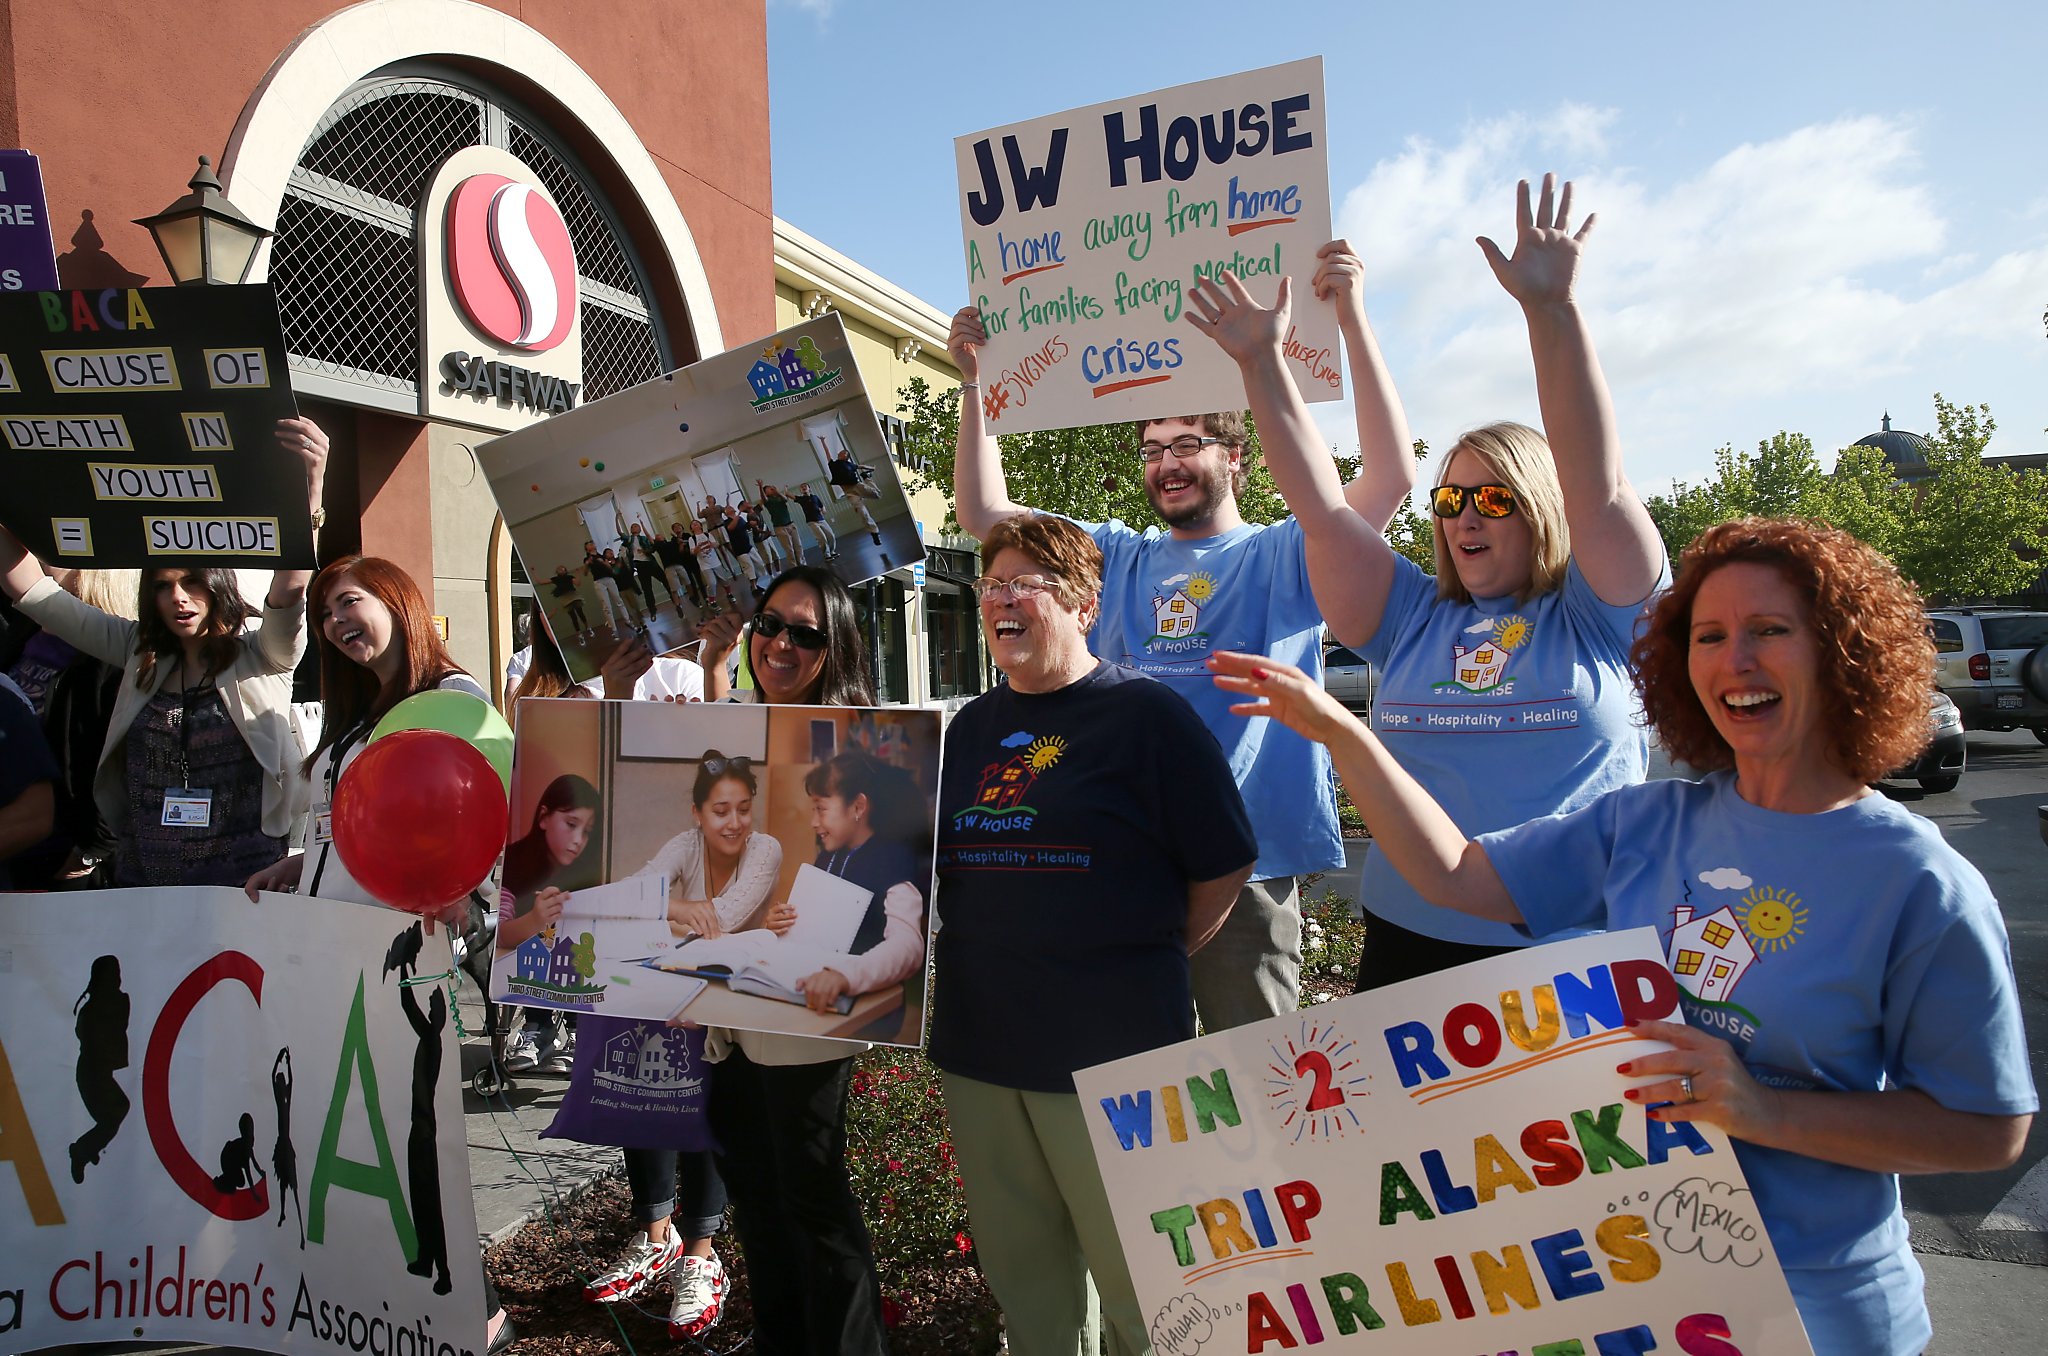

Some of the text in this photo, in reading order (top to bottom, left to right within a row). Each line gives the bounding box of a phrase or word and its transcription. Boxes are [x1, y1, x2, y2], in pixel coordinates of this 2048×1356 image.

[967, 93, 1313, 227] JW HOUSE
[969, 176, 1302, 284] A home away from home
[37, 288, 155, 333] BACA
[978, 294, 1008, 341] for
[1017, 285, 1104, 332] families
[1114, 271, 1182, 323] facing
[53, 353, 171, 388] CAUSE
[213, 352, 261, 385] OF
[446, 350, 582, 413] SAFEWAY
[6, 417, 228, 448] DEATH IN
[94, 467, 215, 498] YOUTH
[151, 519, 275, 551] SUICIDE
[1165, 638, 1208, 655] HOUSE
[1381, 709, 1578, 729] Hope Hospitality Healing
[980, 815, 1033, 833] HOUSE
[957, 850, 1028, 867] Hospitality
[1037, 851, 1090, 867] Healing
[508, 983, 605, 1004] THIRD STREET COMMUNITY CENTER
[1685, 1000, 1755, 1043] HOUSE
[1099, 959, 1681, 1152] WIN 2 ROUND
[590, 1095, 619, 1109] Leading
[619, 1101, 644, 1112] Strong
[644, 1103, 651, 1111] &
[592, 1077, 702, 1098] THIRD STREET COMMUNITY CENTER
[1149, 1100, 1714, 1268] TRIP ALASKA
[1675, 1191, 1757, 1242] MEXICO
[49, 1245, 276, 1328] Children's
[288, 1271, 475, 1356] Associati
[1246, 1213, 1662, 1355] AIRLINES
[1157, 1306, 1204, 1354] HAWAII
